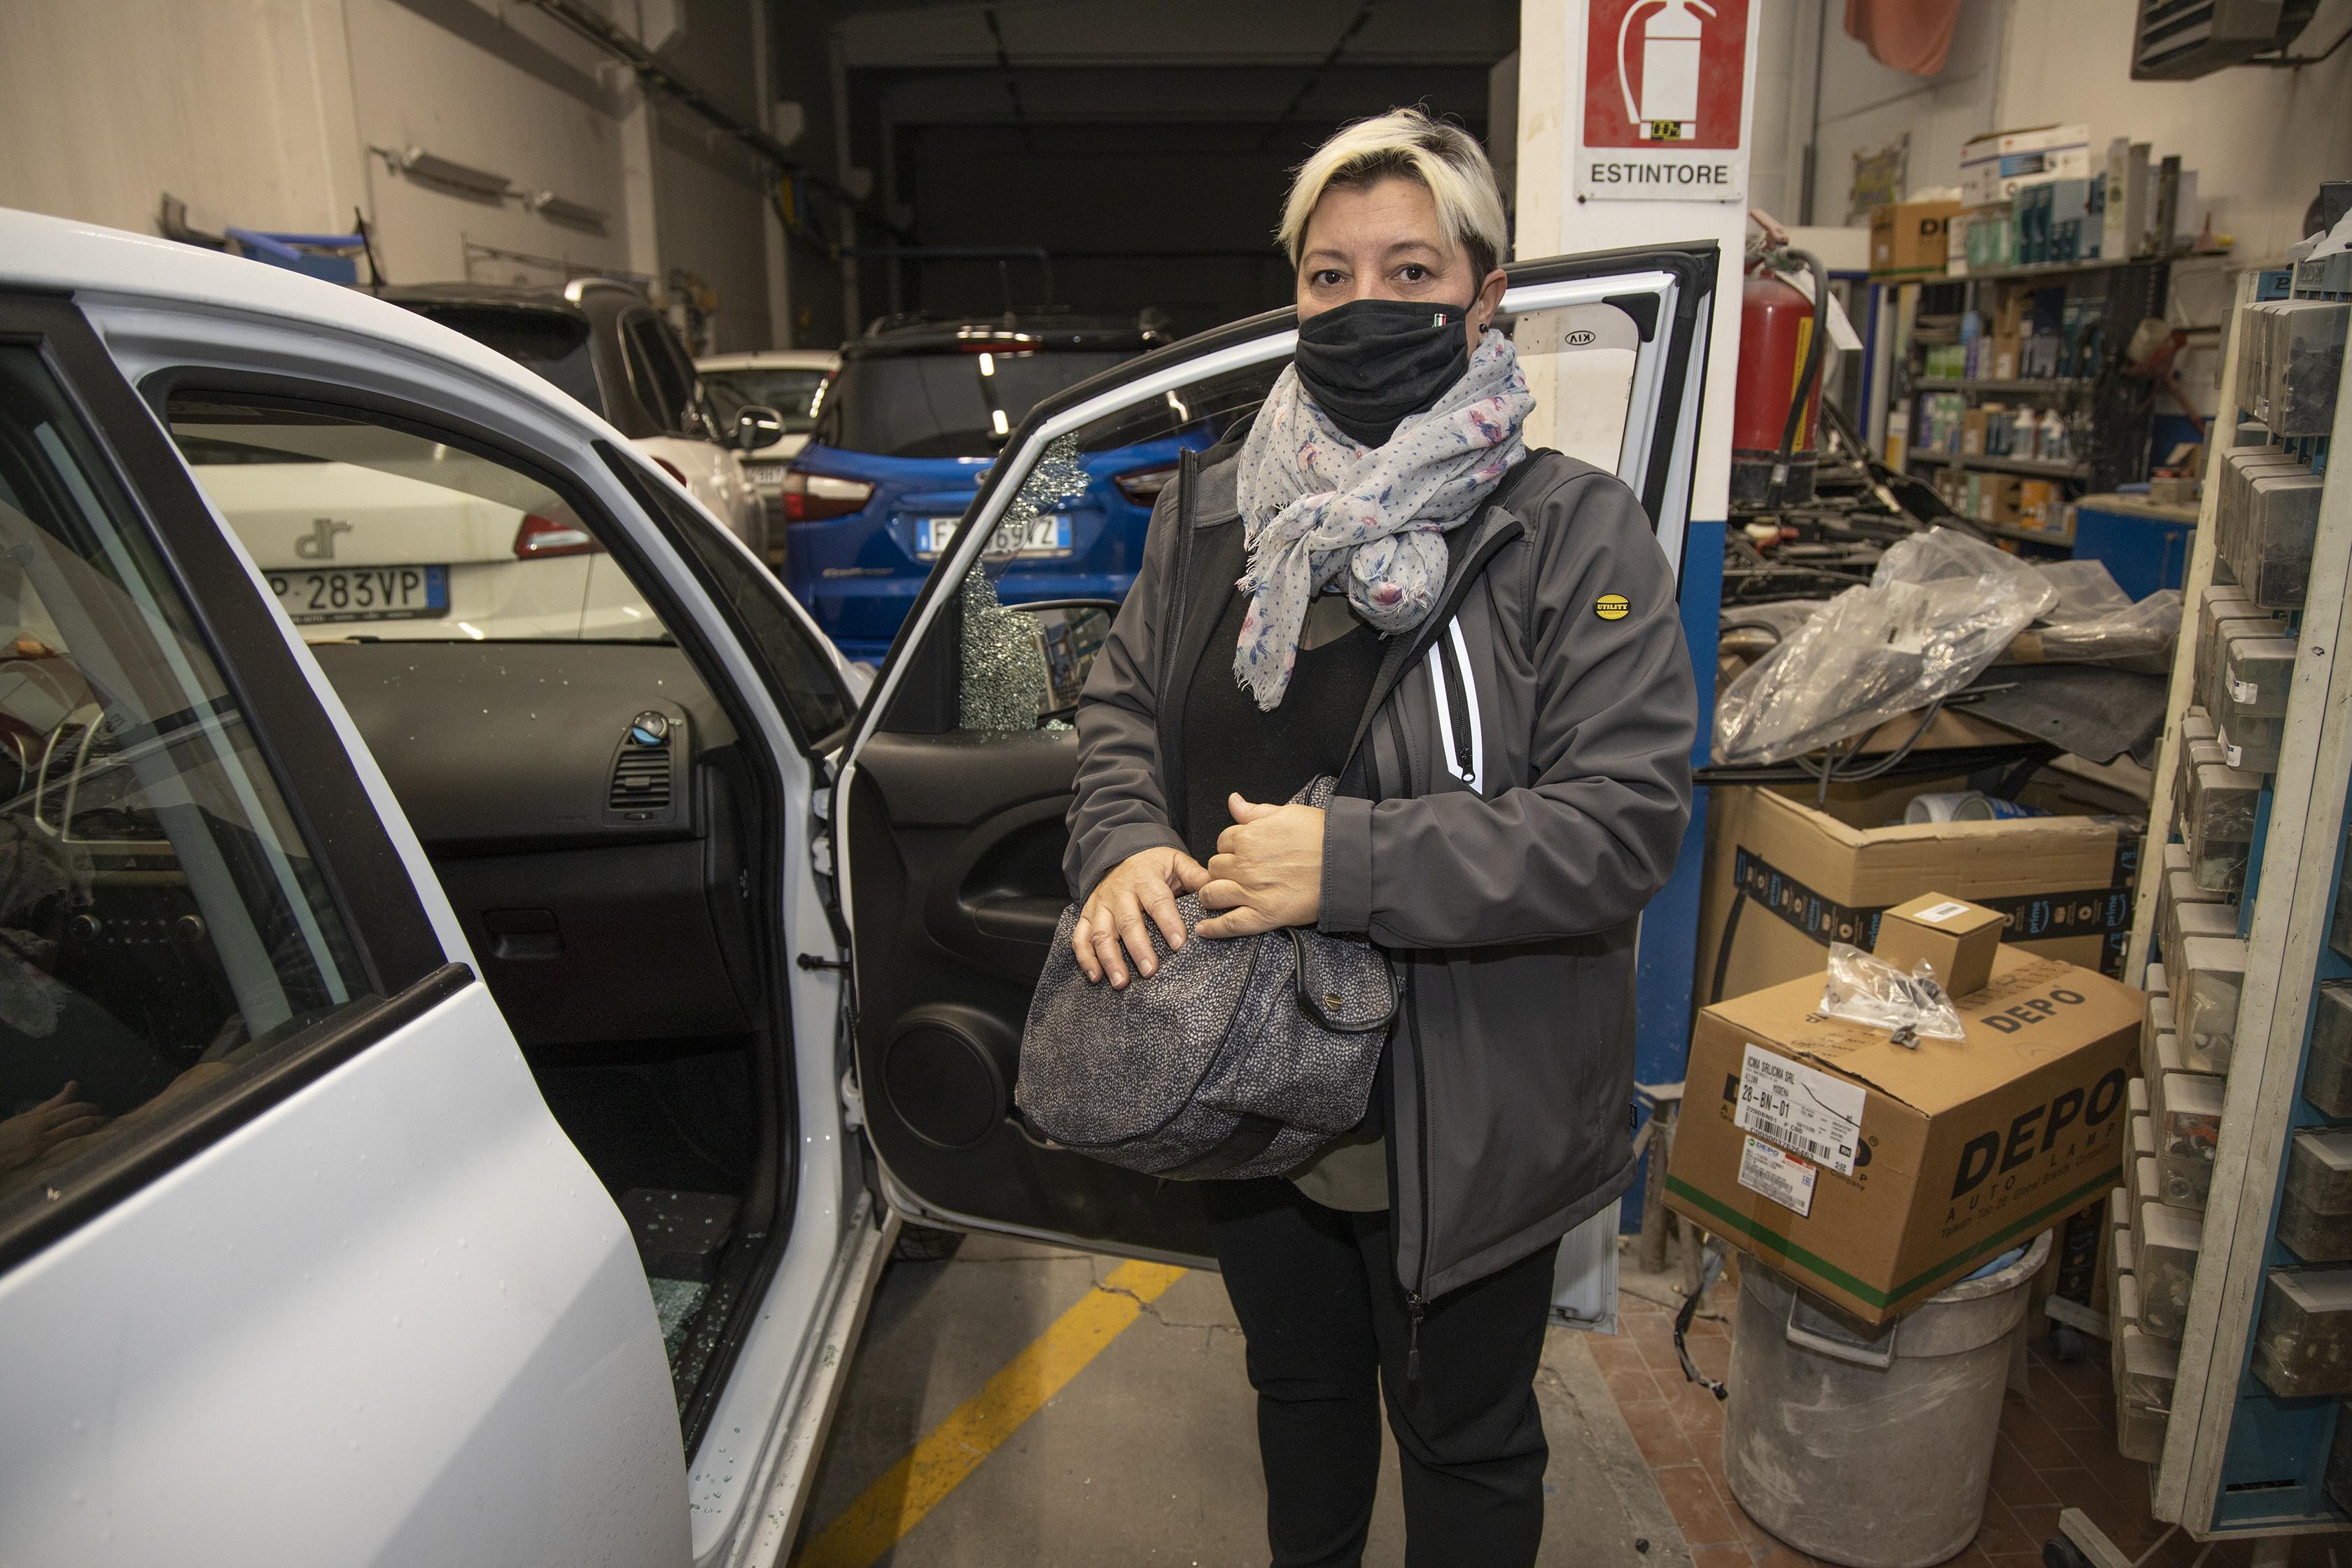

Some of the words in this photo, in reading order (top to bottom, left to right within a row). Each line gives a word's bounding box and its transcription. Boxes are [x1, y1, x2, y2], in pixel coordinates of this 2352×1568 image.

[1590, 163, 1728, 184] ESTINTORE
[307, 571, 419, 610] 283VP
[2031, 901, 2041, 934] prime
[2107, 895, 2118, 927] prime
[1980, 988, 2086, 1035] DEPO
[1785, 1070, 1795, 1085] SRL
[1742, 1084, 1791, 1119] 28-BN-01
[1756, 1142, 1779, 1156] DEPO
[1950, 1068, 2127, 1202] DEPO
[1945, 1175, 2016, 1224] AUTO
